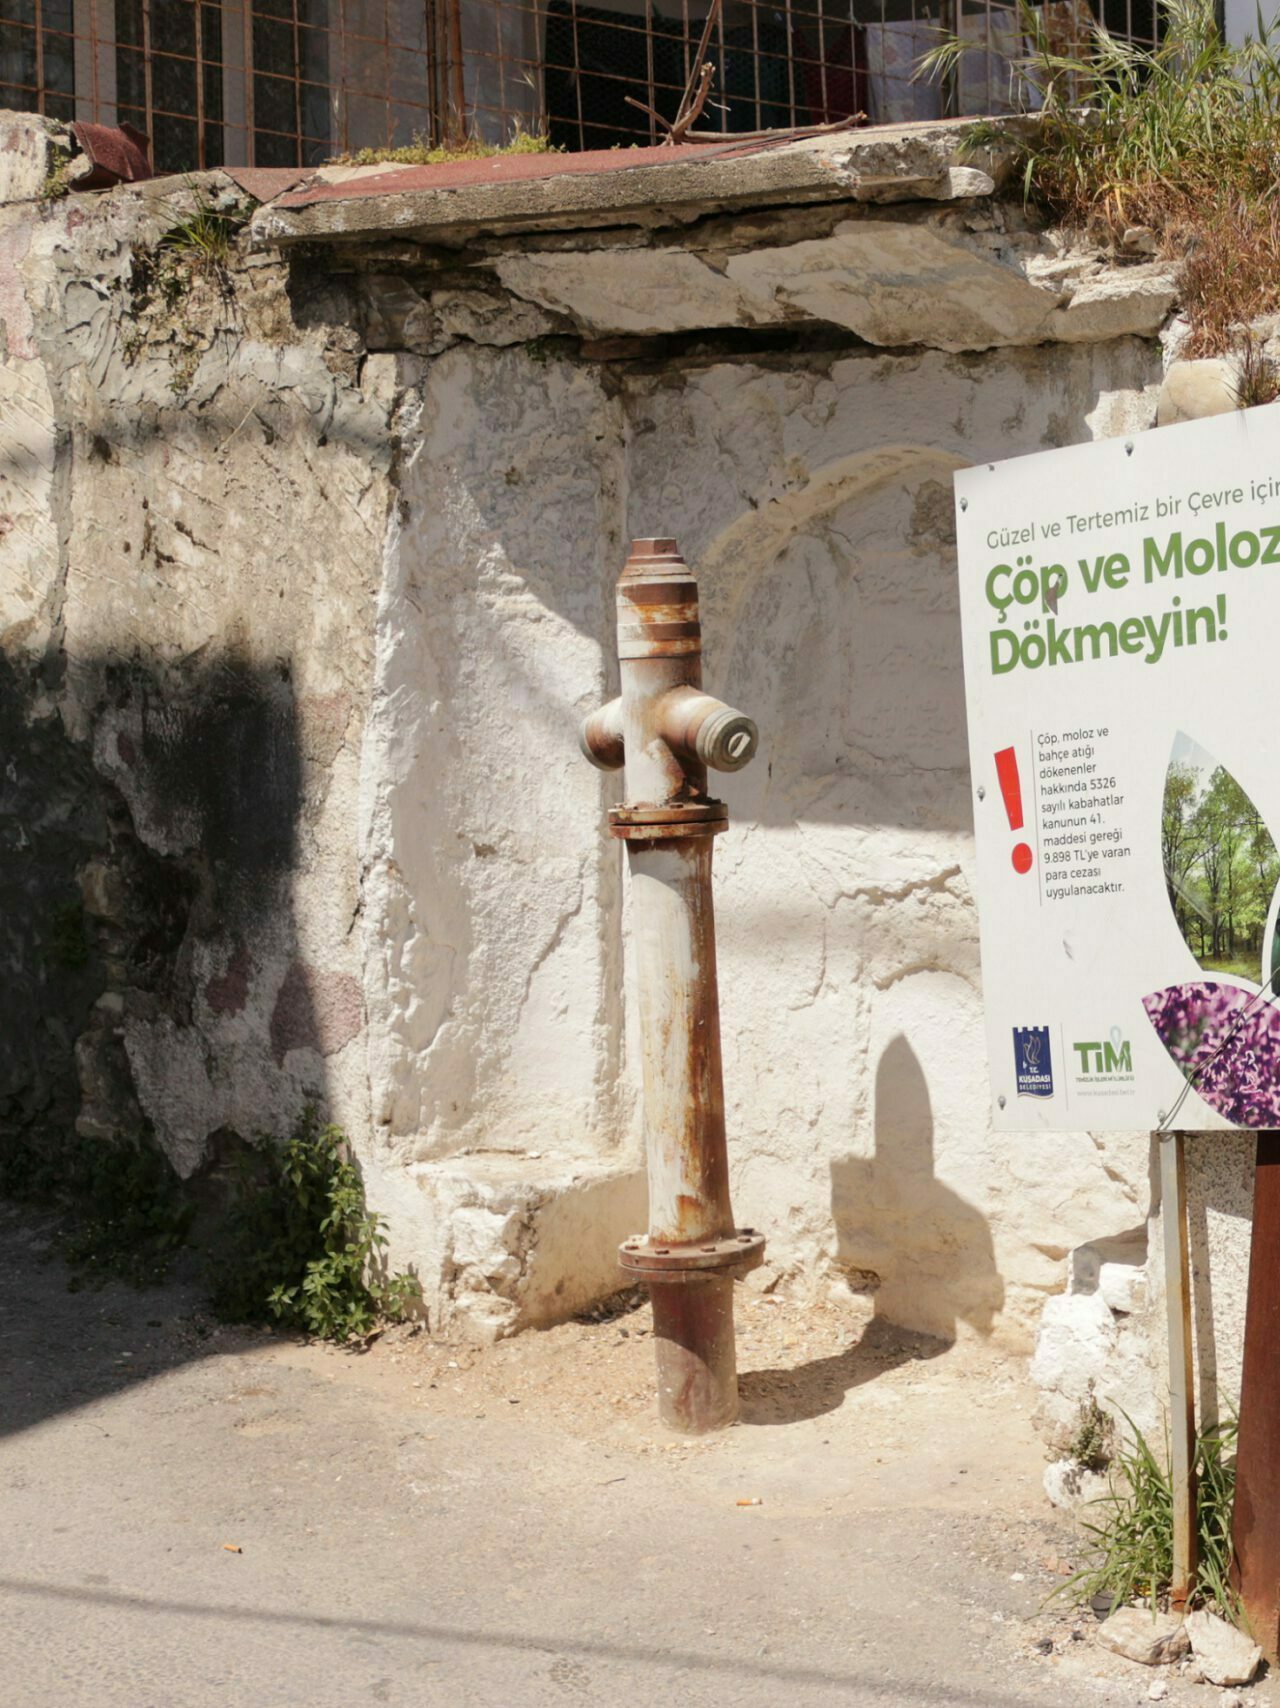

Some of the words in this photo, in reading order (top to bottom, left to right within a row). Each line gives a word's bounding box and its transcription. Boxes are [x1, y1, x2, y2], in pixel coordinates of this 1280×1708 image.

[986, 522, 1036, 549] Güzel
[1041, 523, 1062, 539] ve
[1066, 501, 1150, 536] Tertemiz
[1155, 497, 1183, 518] bir
[1187, 485, 1245, 517] Çevre
[984, 554, 1069, 624] Çöp
[1077, 552, 1131, 594] ve
[989, 593, 1229, 676] Dökmeyin!
[1062, 727, 1095, 742] moloz
[1096, 727, 1110, 737] ve
[1038, 749, 1070, 763] bahçe
[1071, 744, 1095, 760] atığı
[1039, 762, 1097, 779] dökenenler
[1040, 780, 1088, 796] hakkında
[1089, 776, 1117, 791] 5326
[1041, 800, 1067, 815] sayılı
[1068, 793, 1125, 810] kabahatlar
[1042, 816, 1088, 830] kanunun
[1089, 812, 1106, 825] 41.
[1043, 832, 1087, 847] maddesi
[1089, 827, 1123, 845] gereği
[1043, 850, 1072, 864] 9.898
[1101, 847, 1132, 859] varan
[1045, 868, 1069, 883] para
[1070, 867, 1102, 879] cezası
[1046, 881, 1126, 900] uygulanacaktır.
